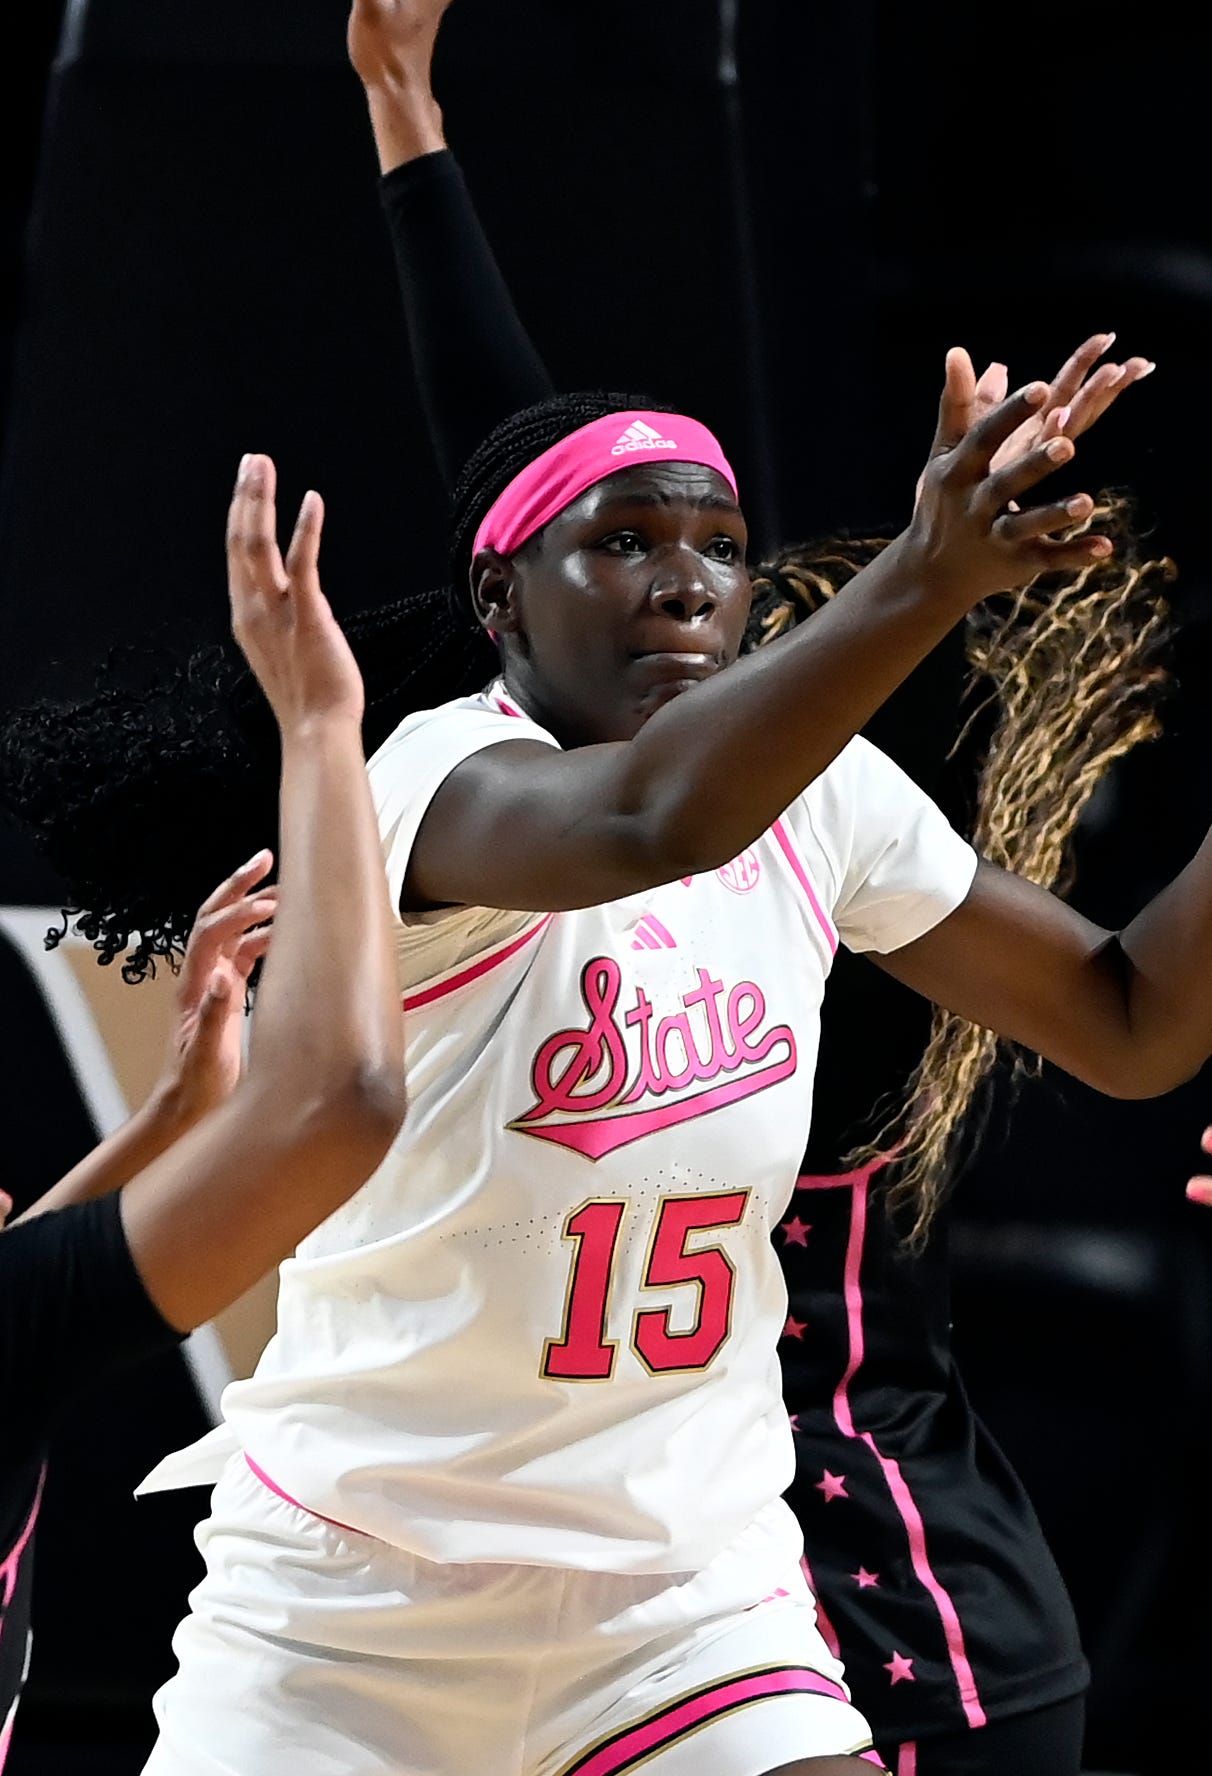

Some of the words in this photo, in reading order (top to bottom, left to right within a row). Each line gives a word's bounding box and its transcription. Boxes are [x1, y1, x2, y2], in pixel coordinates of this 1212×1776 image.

[610, 439, 678, 456] adidas
[504, 956, 798, 1162] State
[538, 1186, 752, 1384] 15
